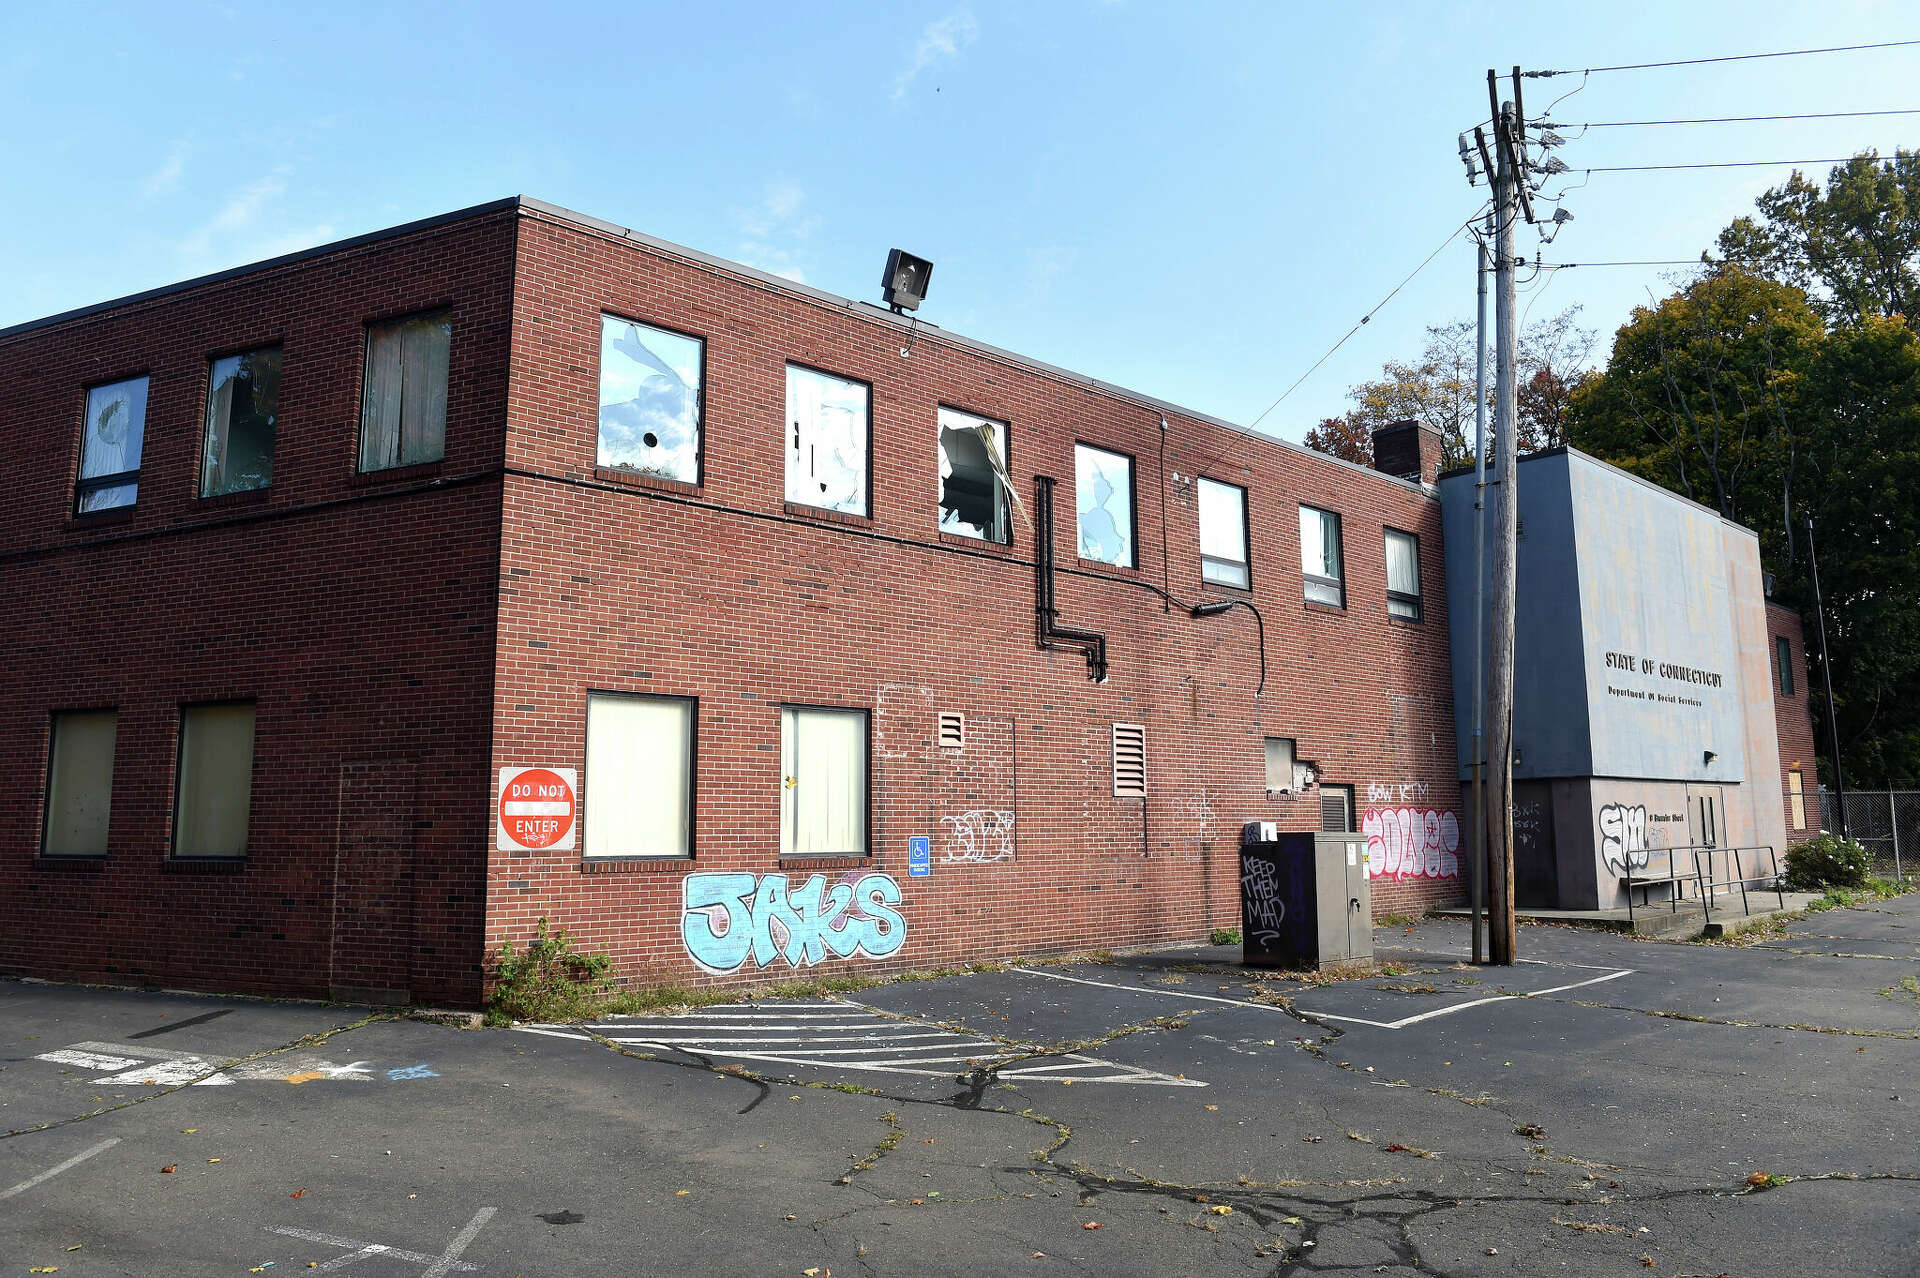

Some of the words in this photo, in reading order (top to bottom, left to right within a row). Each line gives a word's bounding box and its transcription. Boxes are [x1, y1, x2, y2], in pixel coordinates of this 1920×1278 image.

[1605, 651, 1636, 672] STATE
[1641, 658, 1655, 675] OF
[1659, 662, 1722, 688] CONNECTICUT
[1607, 685, 1645, 700] Department
[1657, 693, 1676, 704] Social
[1678, 696, 1702, 707] Services
[512, 784, 531, 797] DO
[538, 784, 565, 798] NOT
[516, 820, 559, 833] ENTER
[1243, 855, 1276, 879] KEEP
[1240, 874, 1280, 900] THEM
[1247, 897, 1286, 929] MAD
